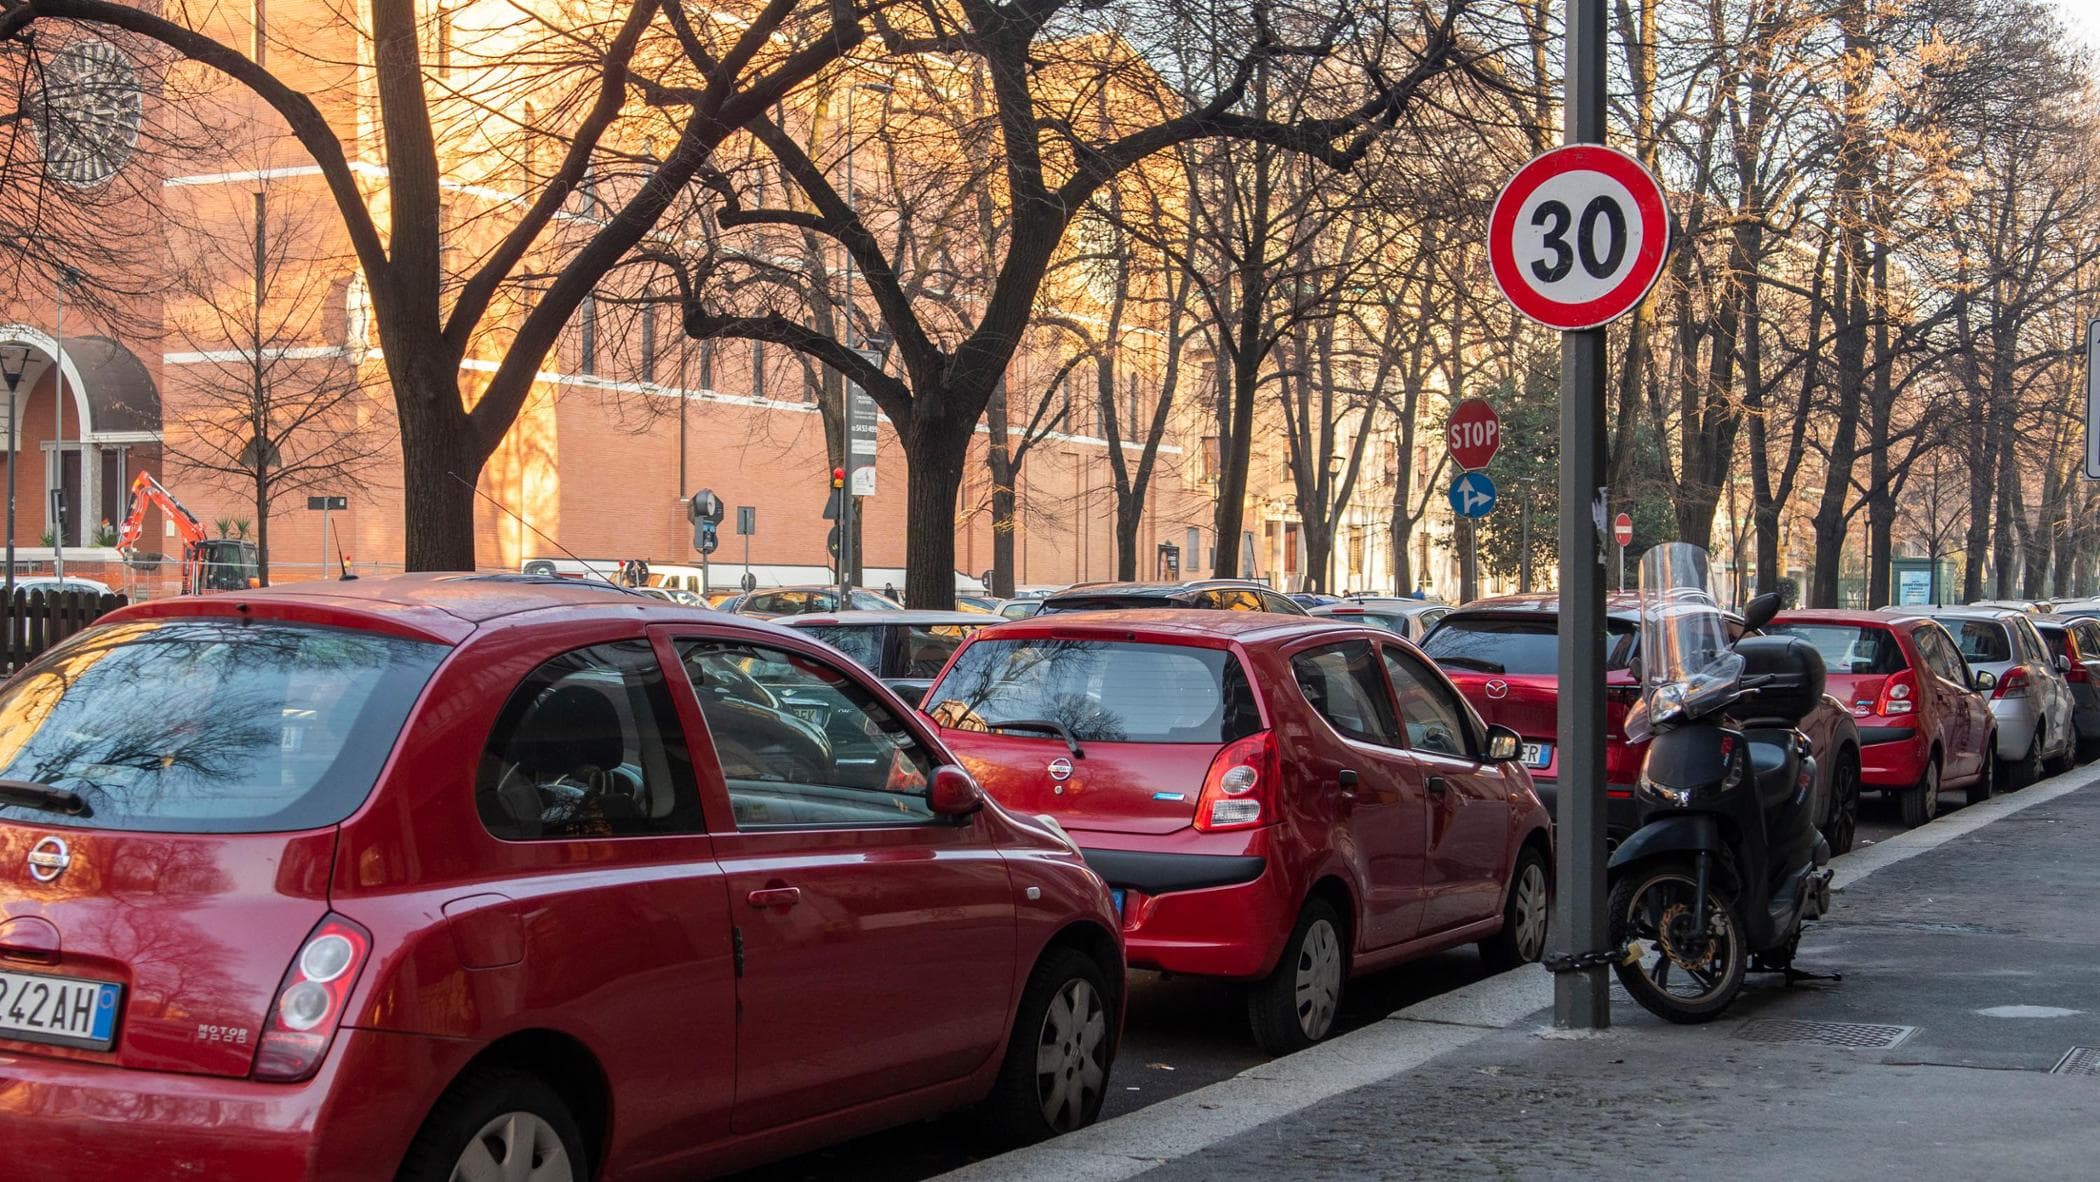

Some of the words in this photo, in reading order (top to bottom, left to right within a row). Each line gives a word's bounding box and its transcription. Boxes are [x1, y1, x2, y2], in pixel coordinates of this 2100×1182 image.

[1531, 195, 1627, 283] 30
[1450, 420, 1497, 449] STOP
[198, 1024, 248, 1037] MOTOR
